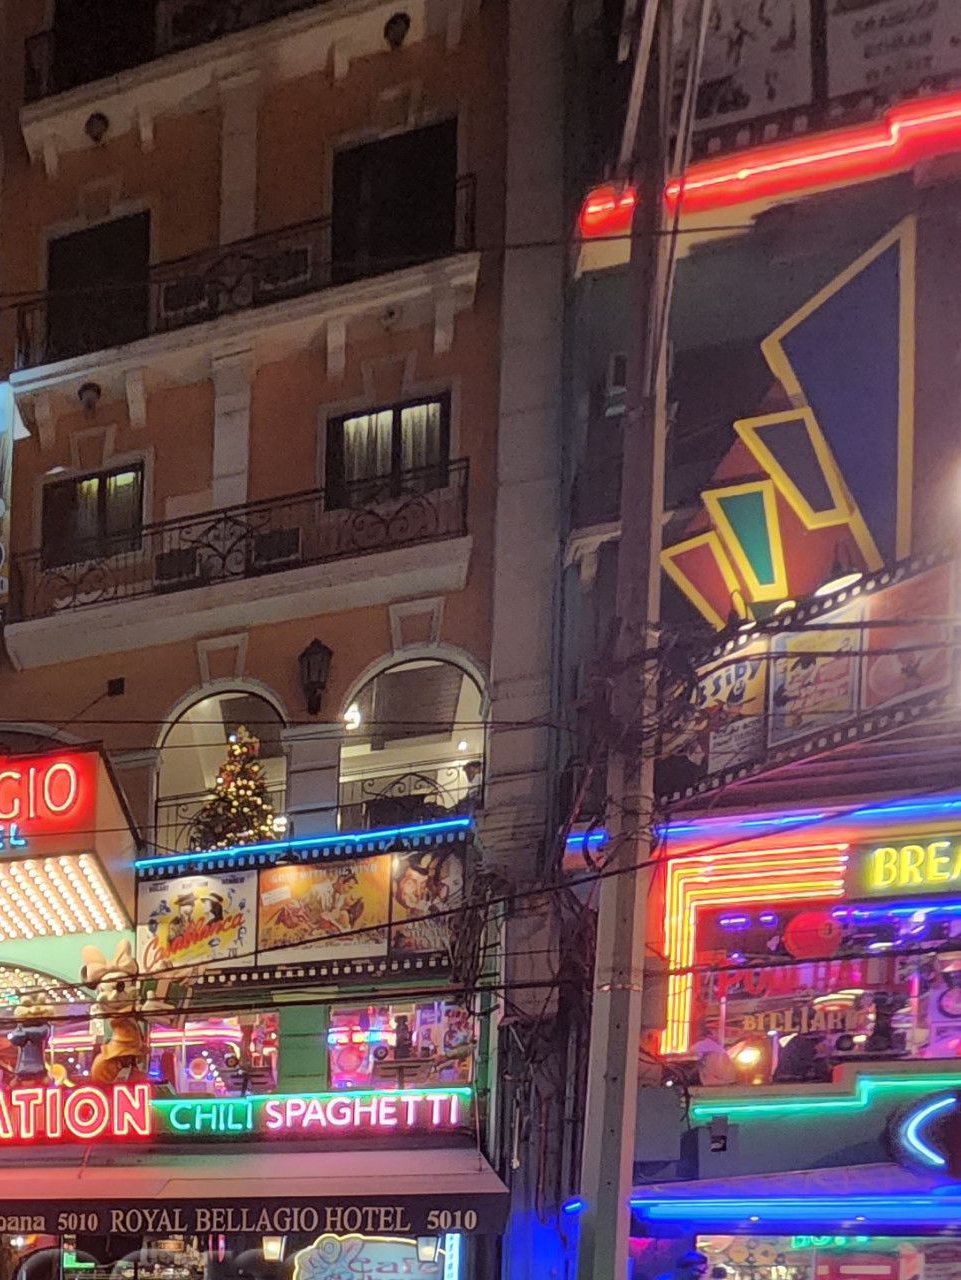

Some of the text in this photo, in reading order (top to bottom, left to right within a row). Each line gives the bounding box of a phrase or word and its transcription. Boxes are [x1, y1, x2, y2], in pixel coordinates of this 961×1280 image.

[168, 1094, 460, 1131] CHILI SPAGHETTI
[57, 1212, 99, 1232] 5010
[110, 1207, 188, 1233] ROYAL
[194, 1206, 320, 1234] BELLAGIO
[324, 1205, 412, 1232] HOTEL
[426, 1209, 477, 1230] 5010
[347, 1256, 439, 1275] Cafe
